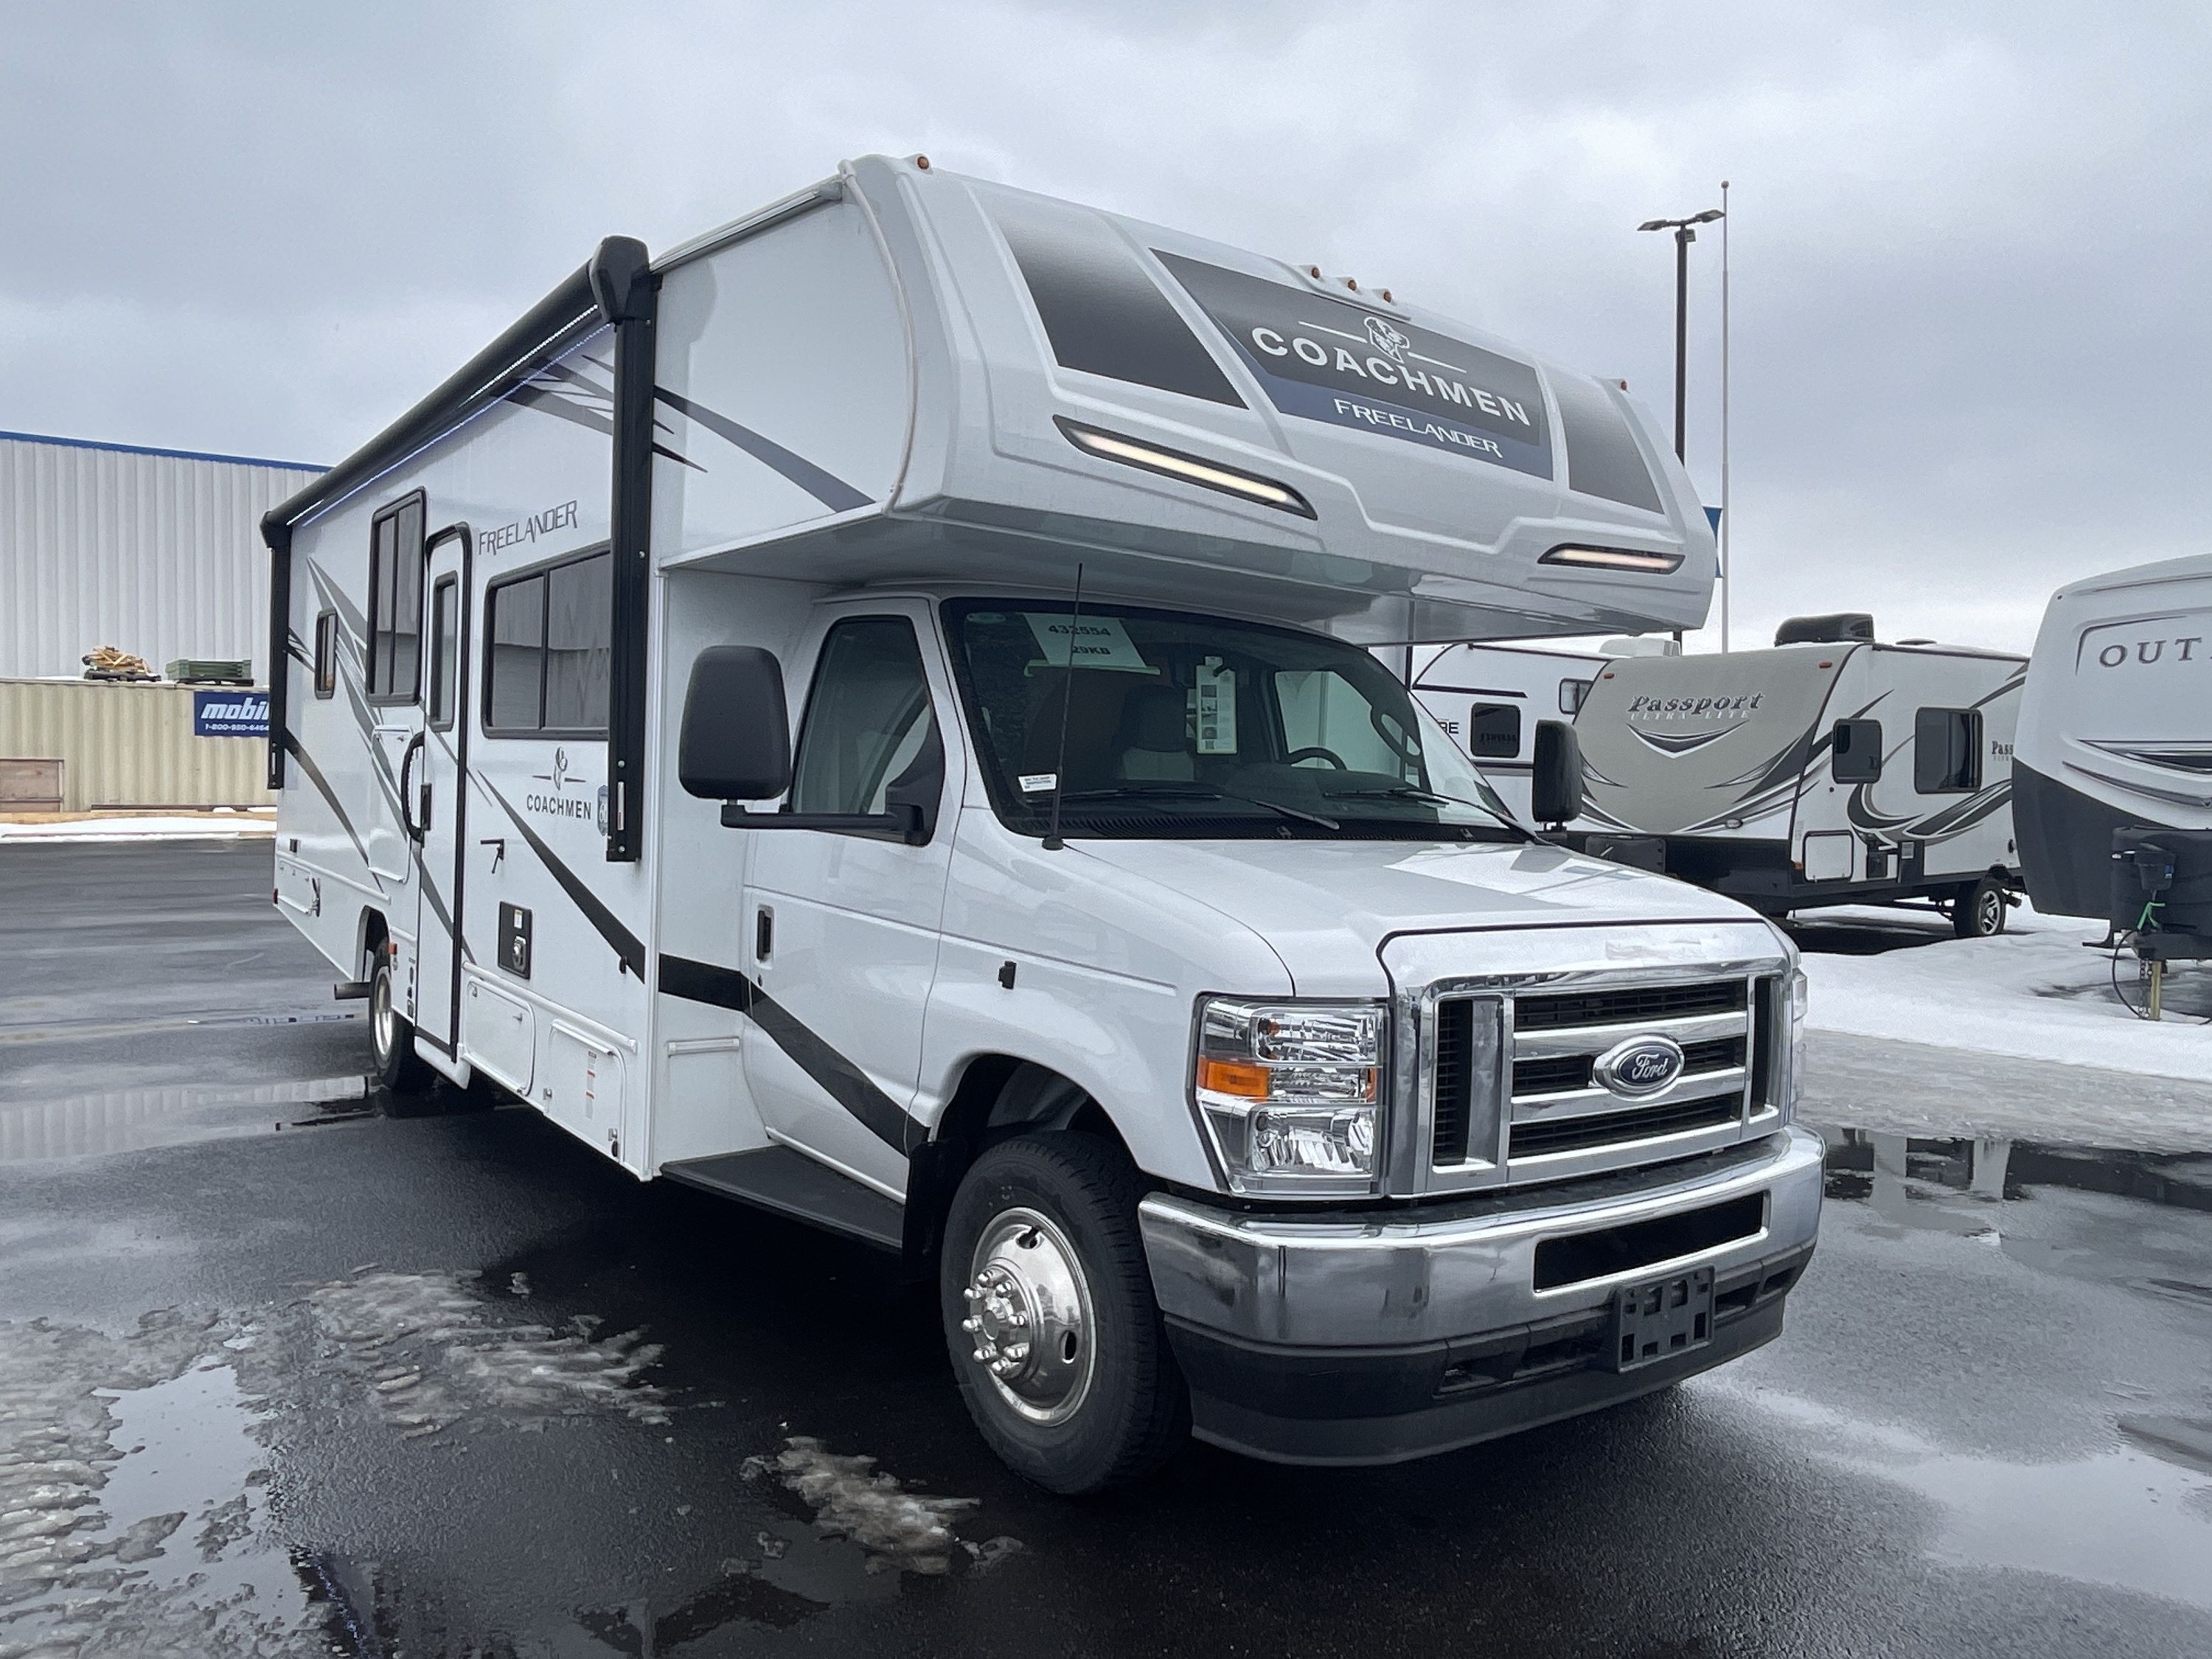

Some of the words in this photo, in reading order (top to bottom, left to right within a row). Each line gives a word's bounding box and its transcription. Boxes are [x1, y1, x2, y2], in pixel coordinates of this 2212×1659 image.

[1253, 327, 1531, 425] COACHMEN
[1334, 398, 1503, 458] FREELANDER
[479, 500, 577, 556] FREELANDER
[1628, 692, 1764, 714] Passport
[1704, 710, 1750, 720] LITE
[526, 794, 591, 820] COACHMEN
[1632, 1053, 1669, 1079] Ford
